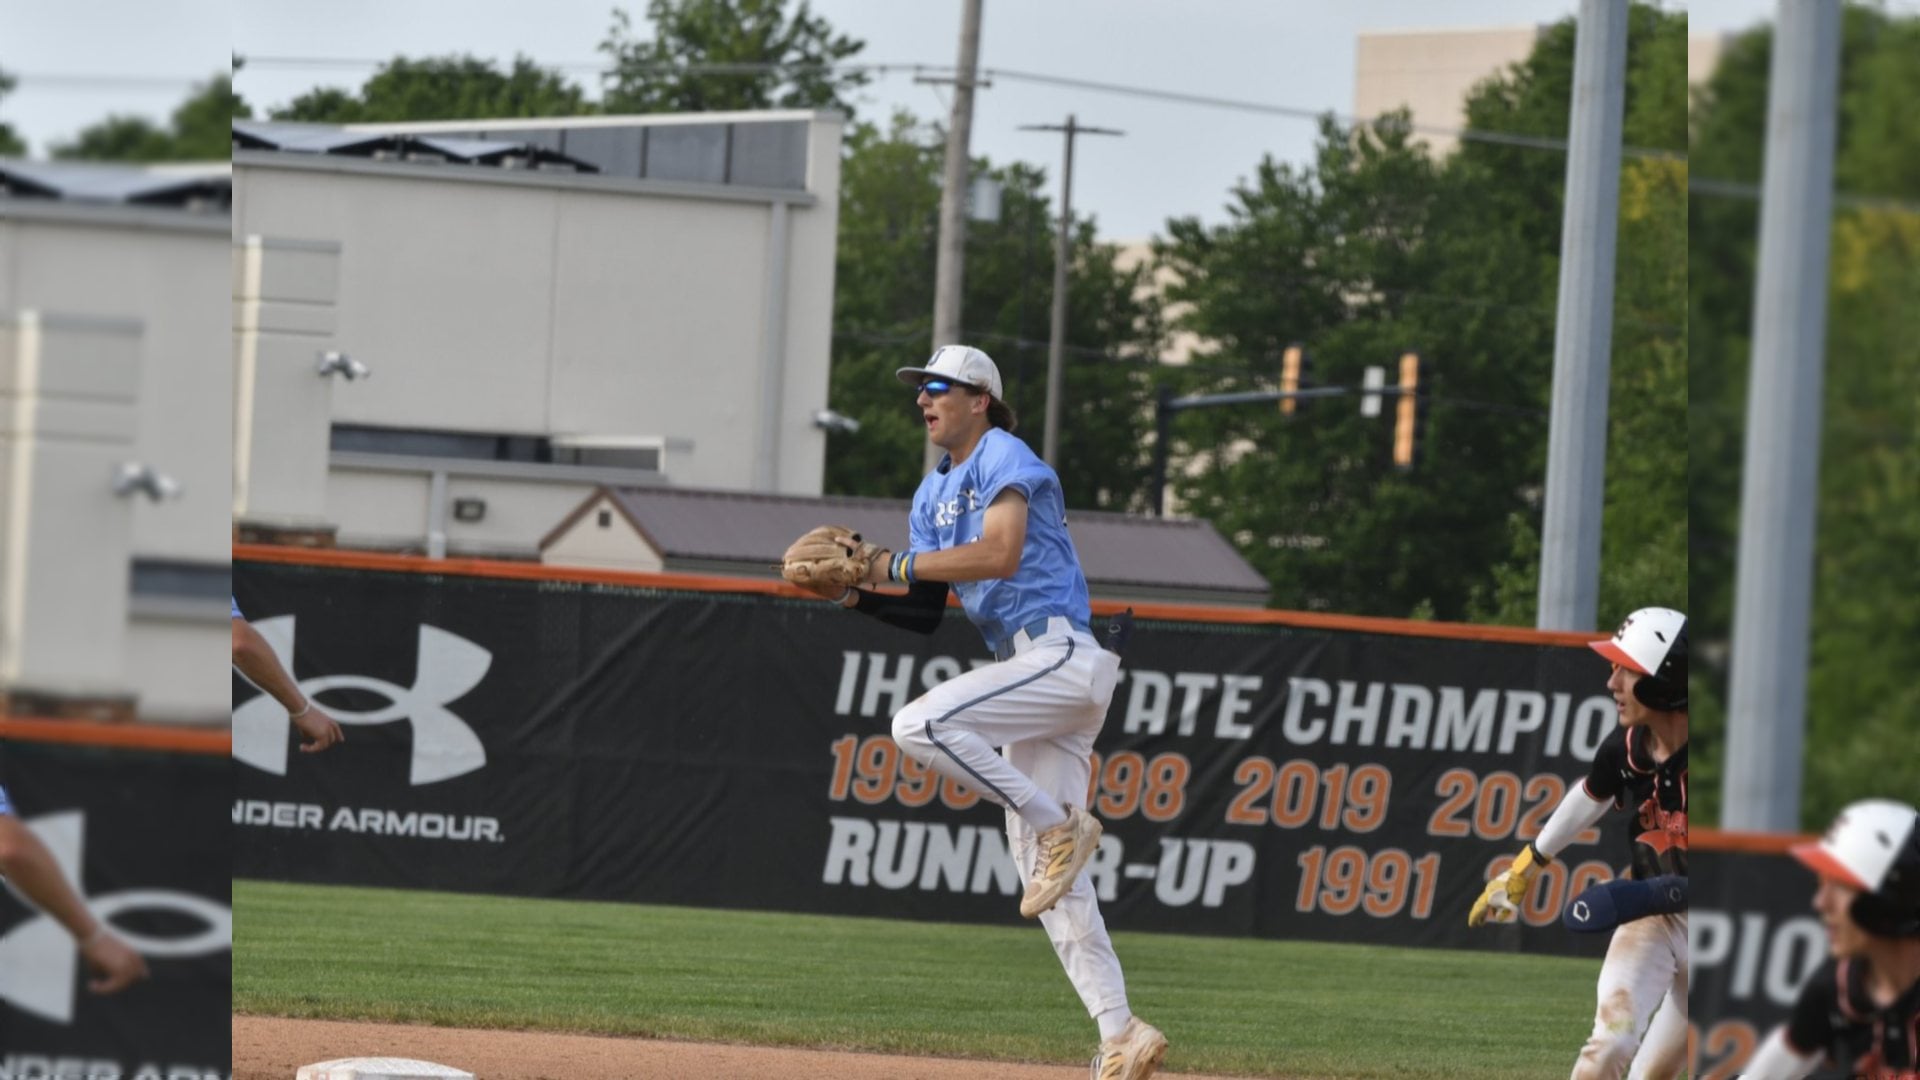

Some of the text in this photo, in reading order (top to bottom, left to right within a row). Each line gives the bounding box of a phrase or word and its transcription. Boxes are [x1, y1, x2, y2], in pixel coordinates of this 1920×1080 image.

[1225, 756, 1391, 833] 2019
[1427, 767, 1601, 845] 202
[822, 817, 1256, 908] RUNNR-UP
[1296, 845, 1441, 920] 1991
